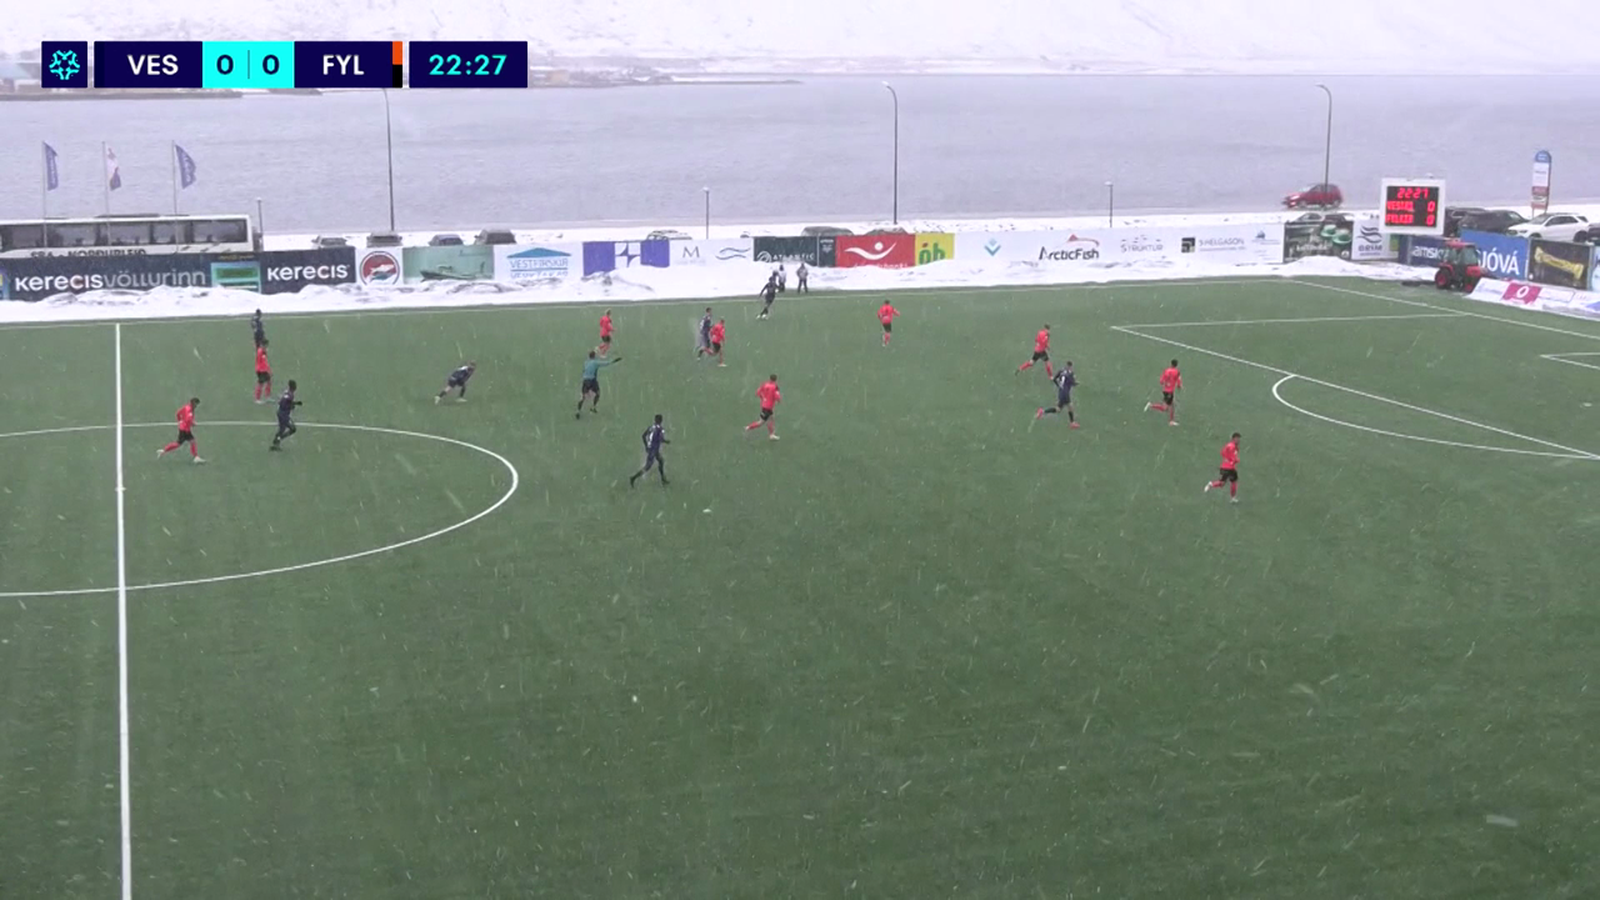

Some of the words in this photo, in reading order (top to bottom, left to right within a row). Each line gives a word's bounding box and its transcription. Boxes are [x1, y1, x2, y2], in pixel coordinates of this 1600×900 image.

[1427, 200, 1436, 212] 0
[1426, 214, 1435, 226] 0
[682, 246, 700, 258] M
[1039, 246, 1100, 261] ArcticFish
